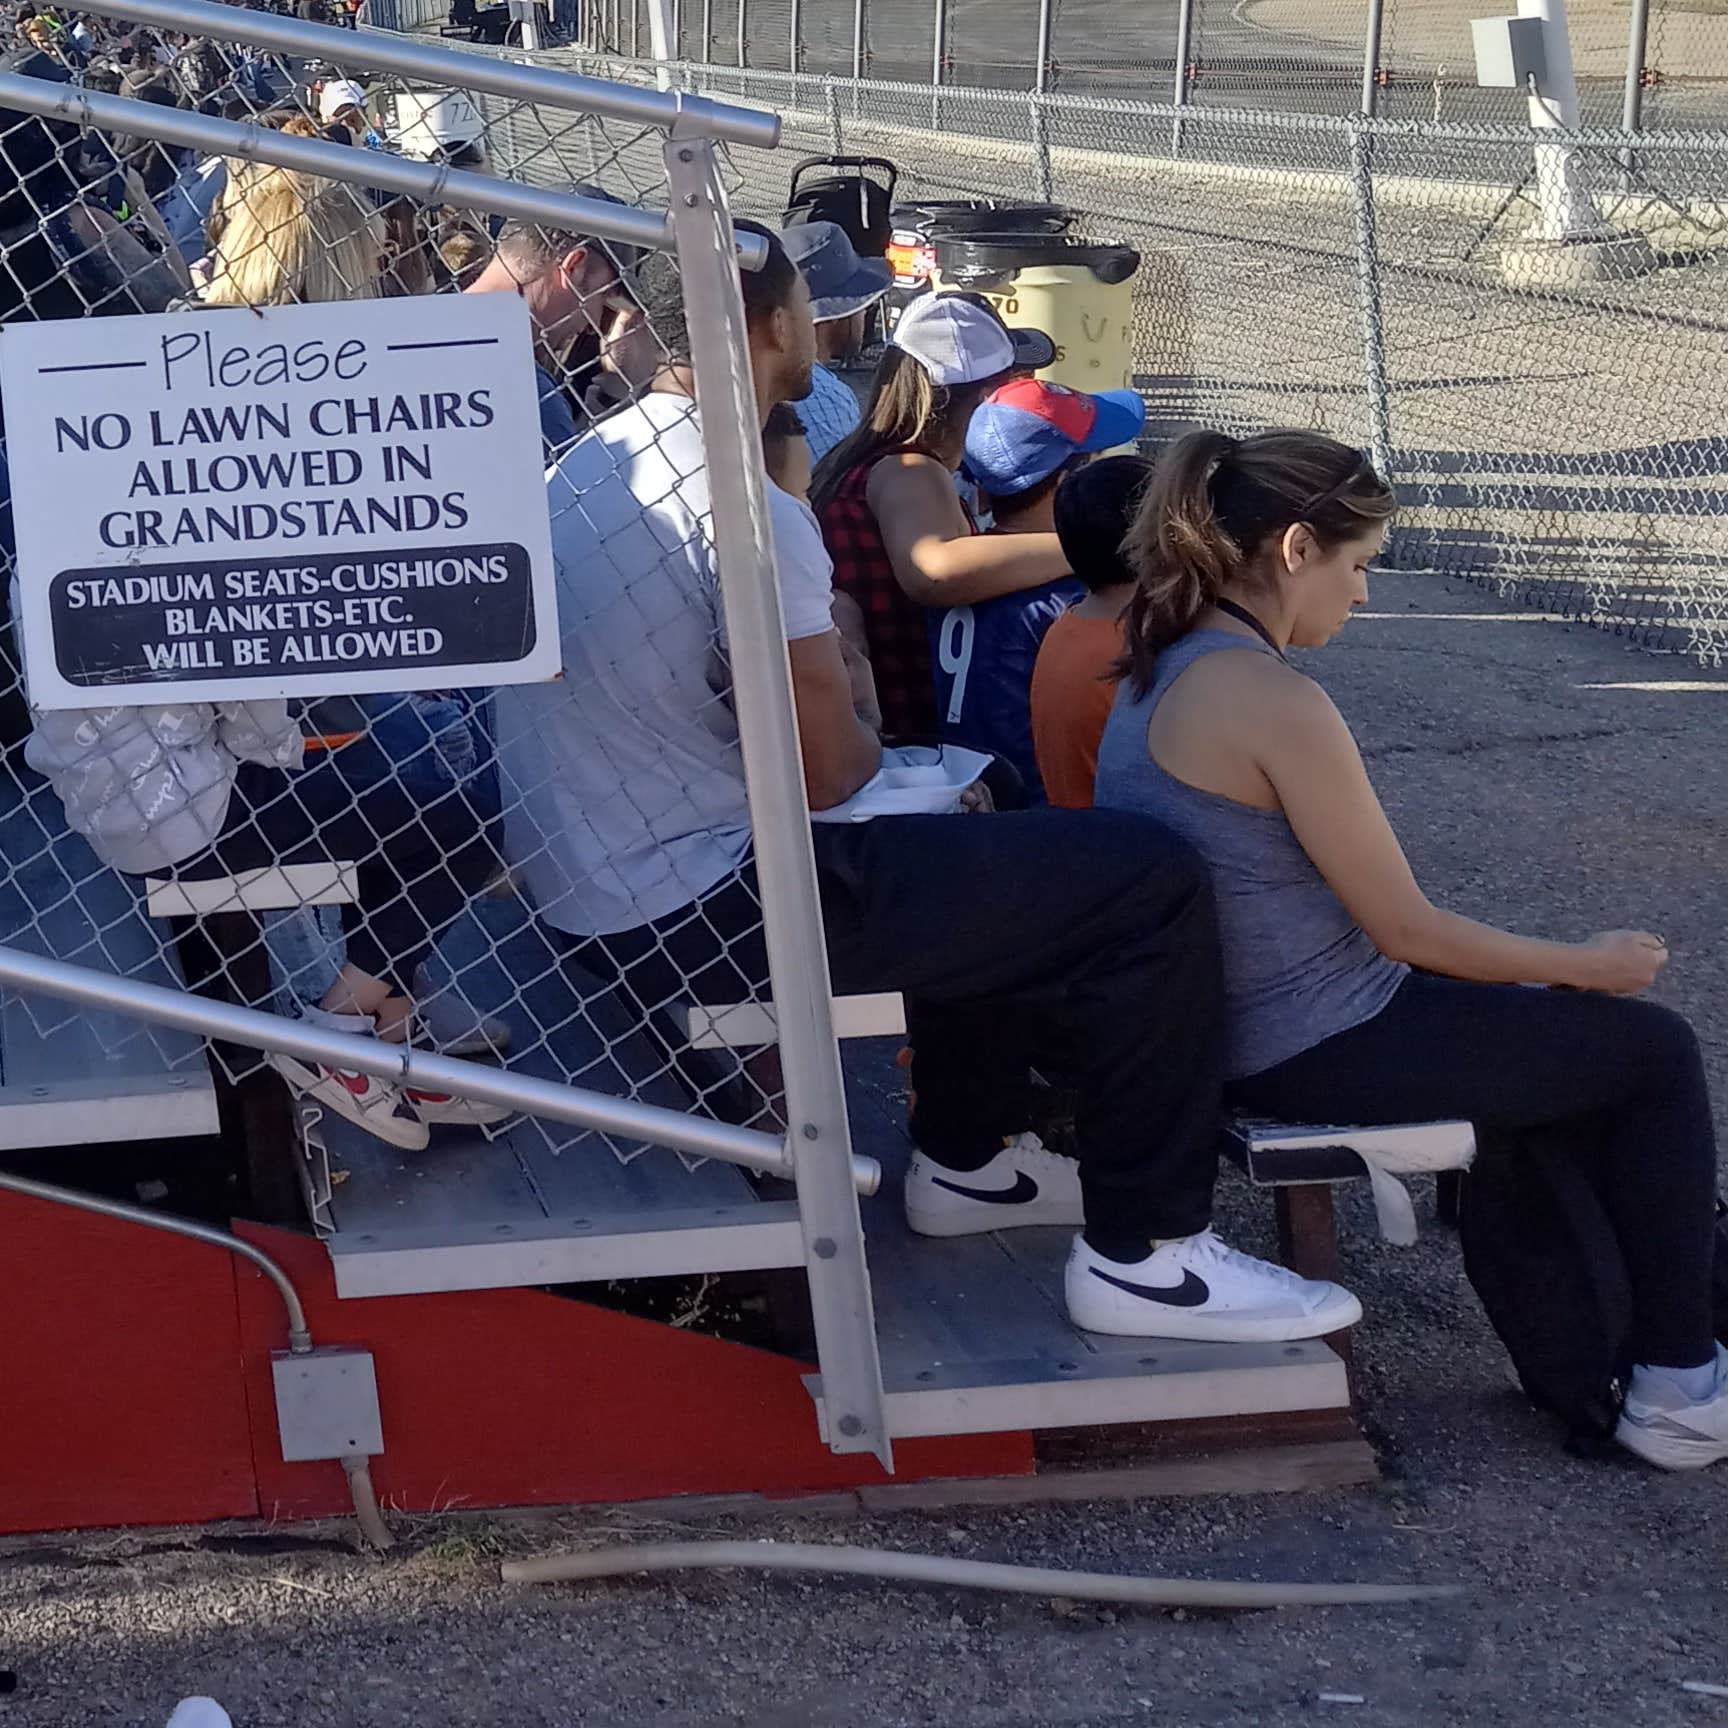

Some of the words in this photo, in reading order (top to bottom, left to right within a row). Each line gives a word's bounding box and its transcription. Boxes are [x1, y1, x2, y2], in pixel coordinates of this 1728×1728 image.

[161, 330, 368, 391] Please
[54, 413, 132, 453] NO
[149, 402, 291, 447] LAWN
[309, 389, 494, 437] CHAIRS
[127, 448, 363, 498] ALLOWED
[381, 443, 433, 483] IN
[99, 491, 469, 549] GRANDSTANDS
[67, 573, 215, 608] STADIUM
[225, 555, 509, 599] SEATS-CUSHIONS
[165, 596, 414, 635] BLANKETS-ETC.
[142, 641, 223, 670] WILL
[232, 638, 271, 666] BE
[280, 628, 443, 663] ALLOWED
[938, 605, 976, 724] 9
